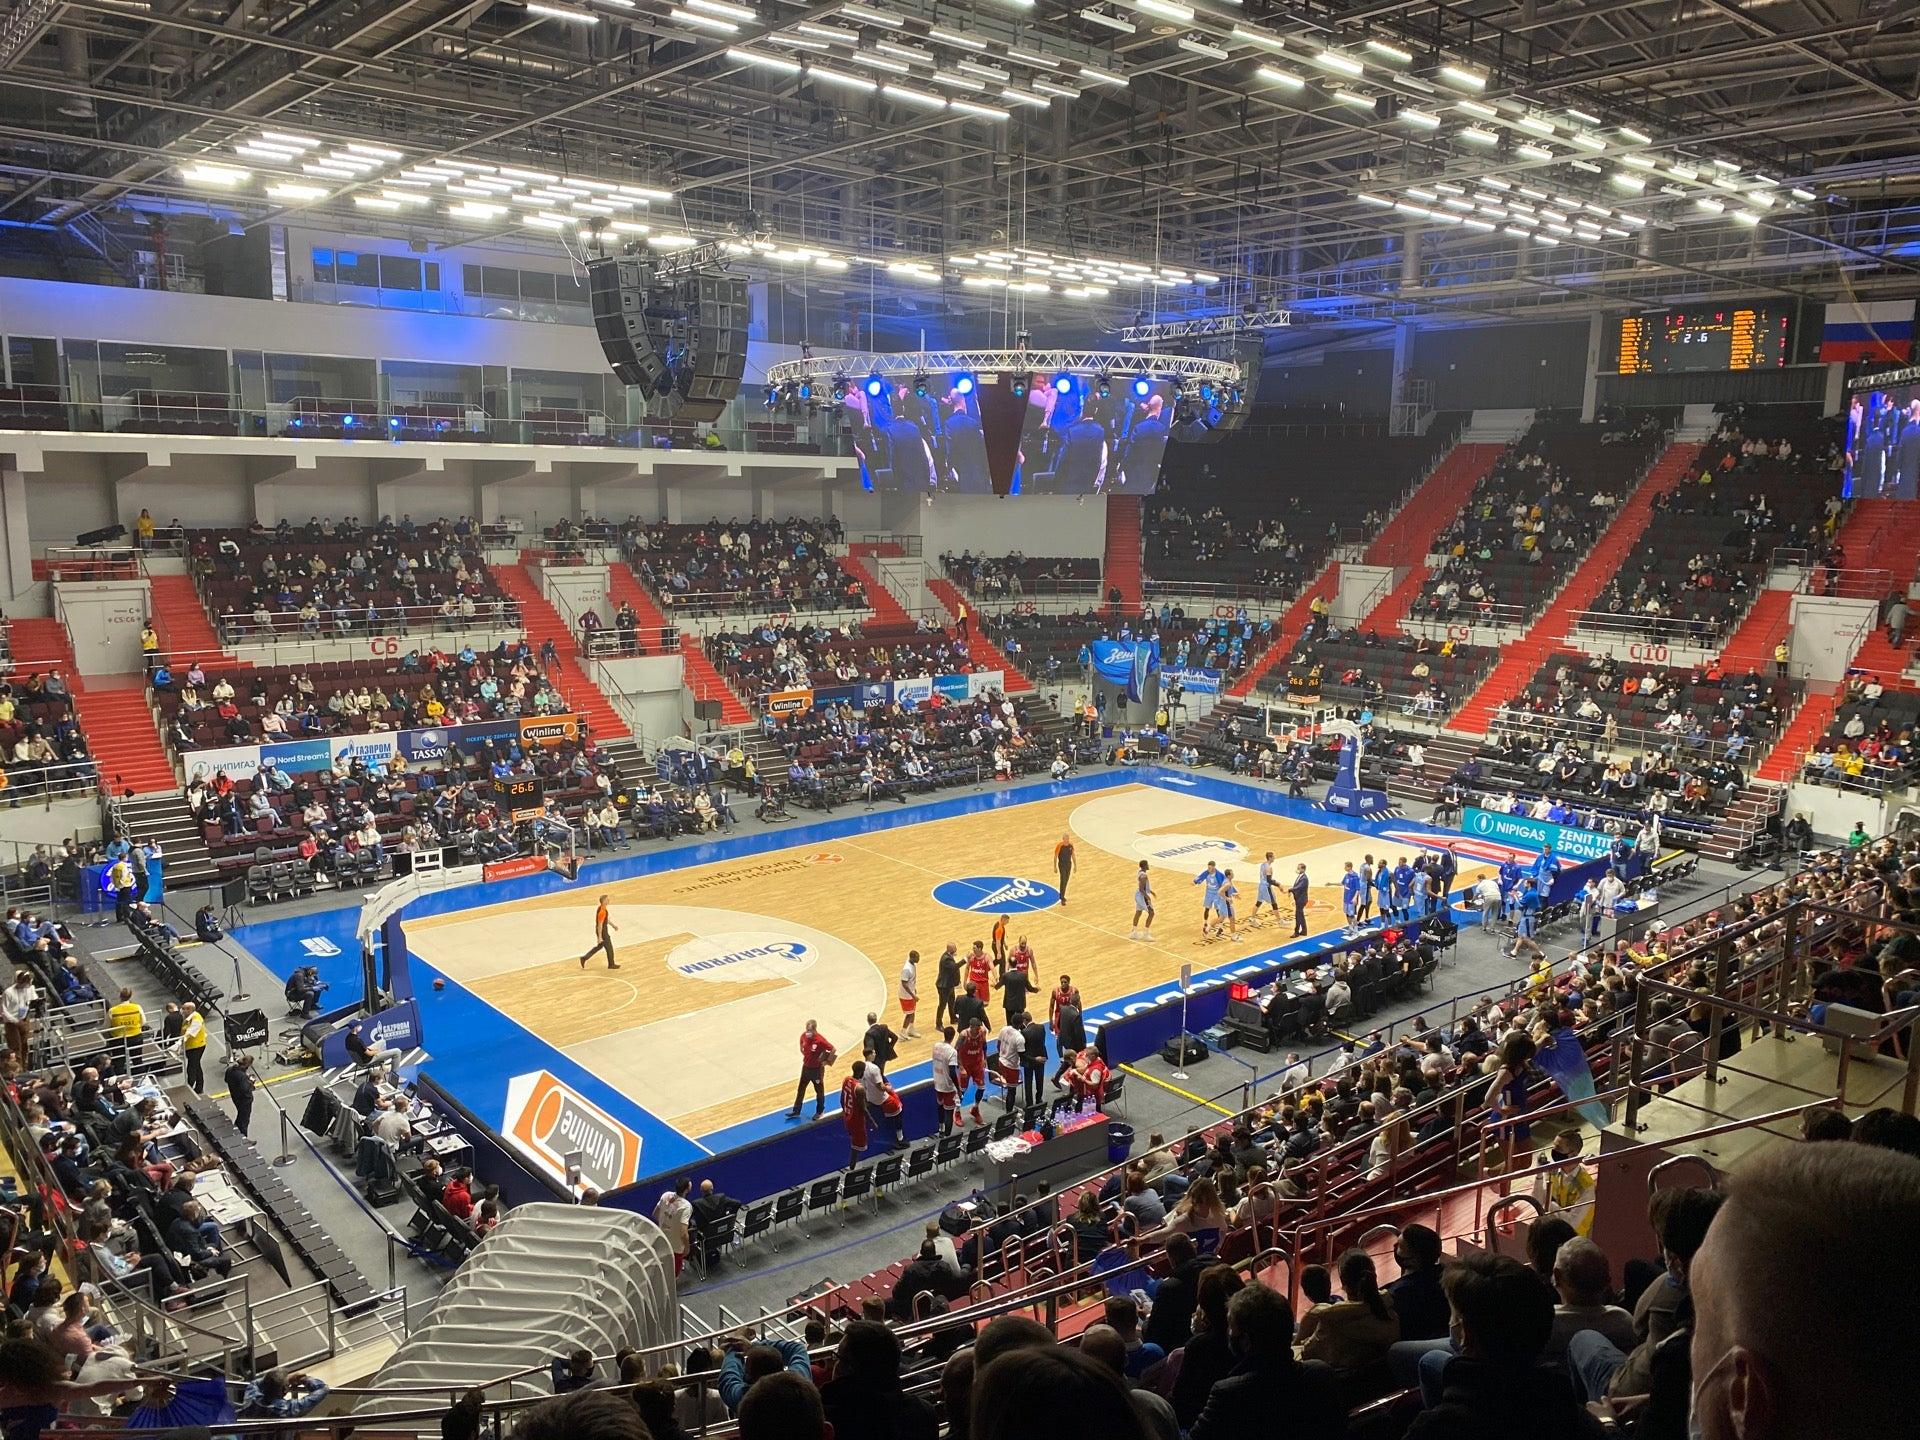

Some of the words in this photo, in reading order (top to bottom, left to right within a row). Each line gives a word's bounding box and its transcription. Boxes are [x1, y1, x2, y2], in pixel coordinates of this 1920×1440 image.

[774, 701, 801, 710] Winline
[526, 726, 562, 738] Winline
[277, 754, 296, 764] Nord
[296, 752, 324, 763] Stream
[411, 747, 448, 760] TASSAY
[213, 760, 256, 771] НИПИГАЗ
[511, 781, 534, 795] 26.6
[1496, 820, 1546, 842] NIPIGAS
[1558, 829, 1595, 845] ZENIT
[678, 947, 769, 974] GAZPROM
[383, 1021, 410, 1034] GAZPROM
[236, 1028, 266, 1042] SPALDING
[560, 1110, 616, 1181] Winline
